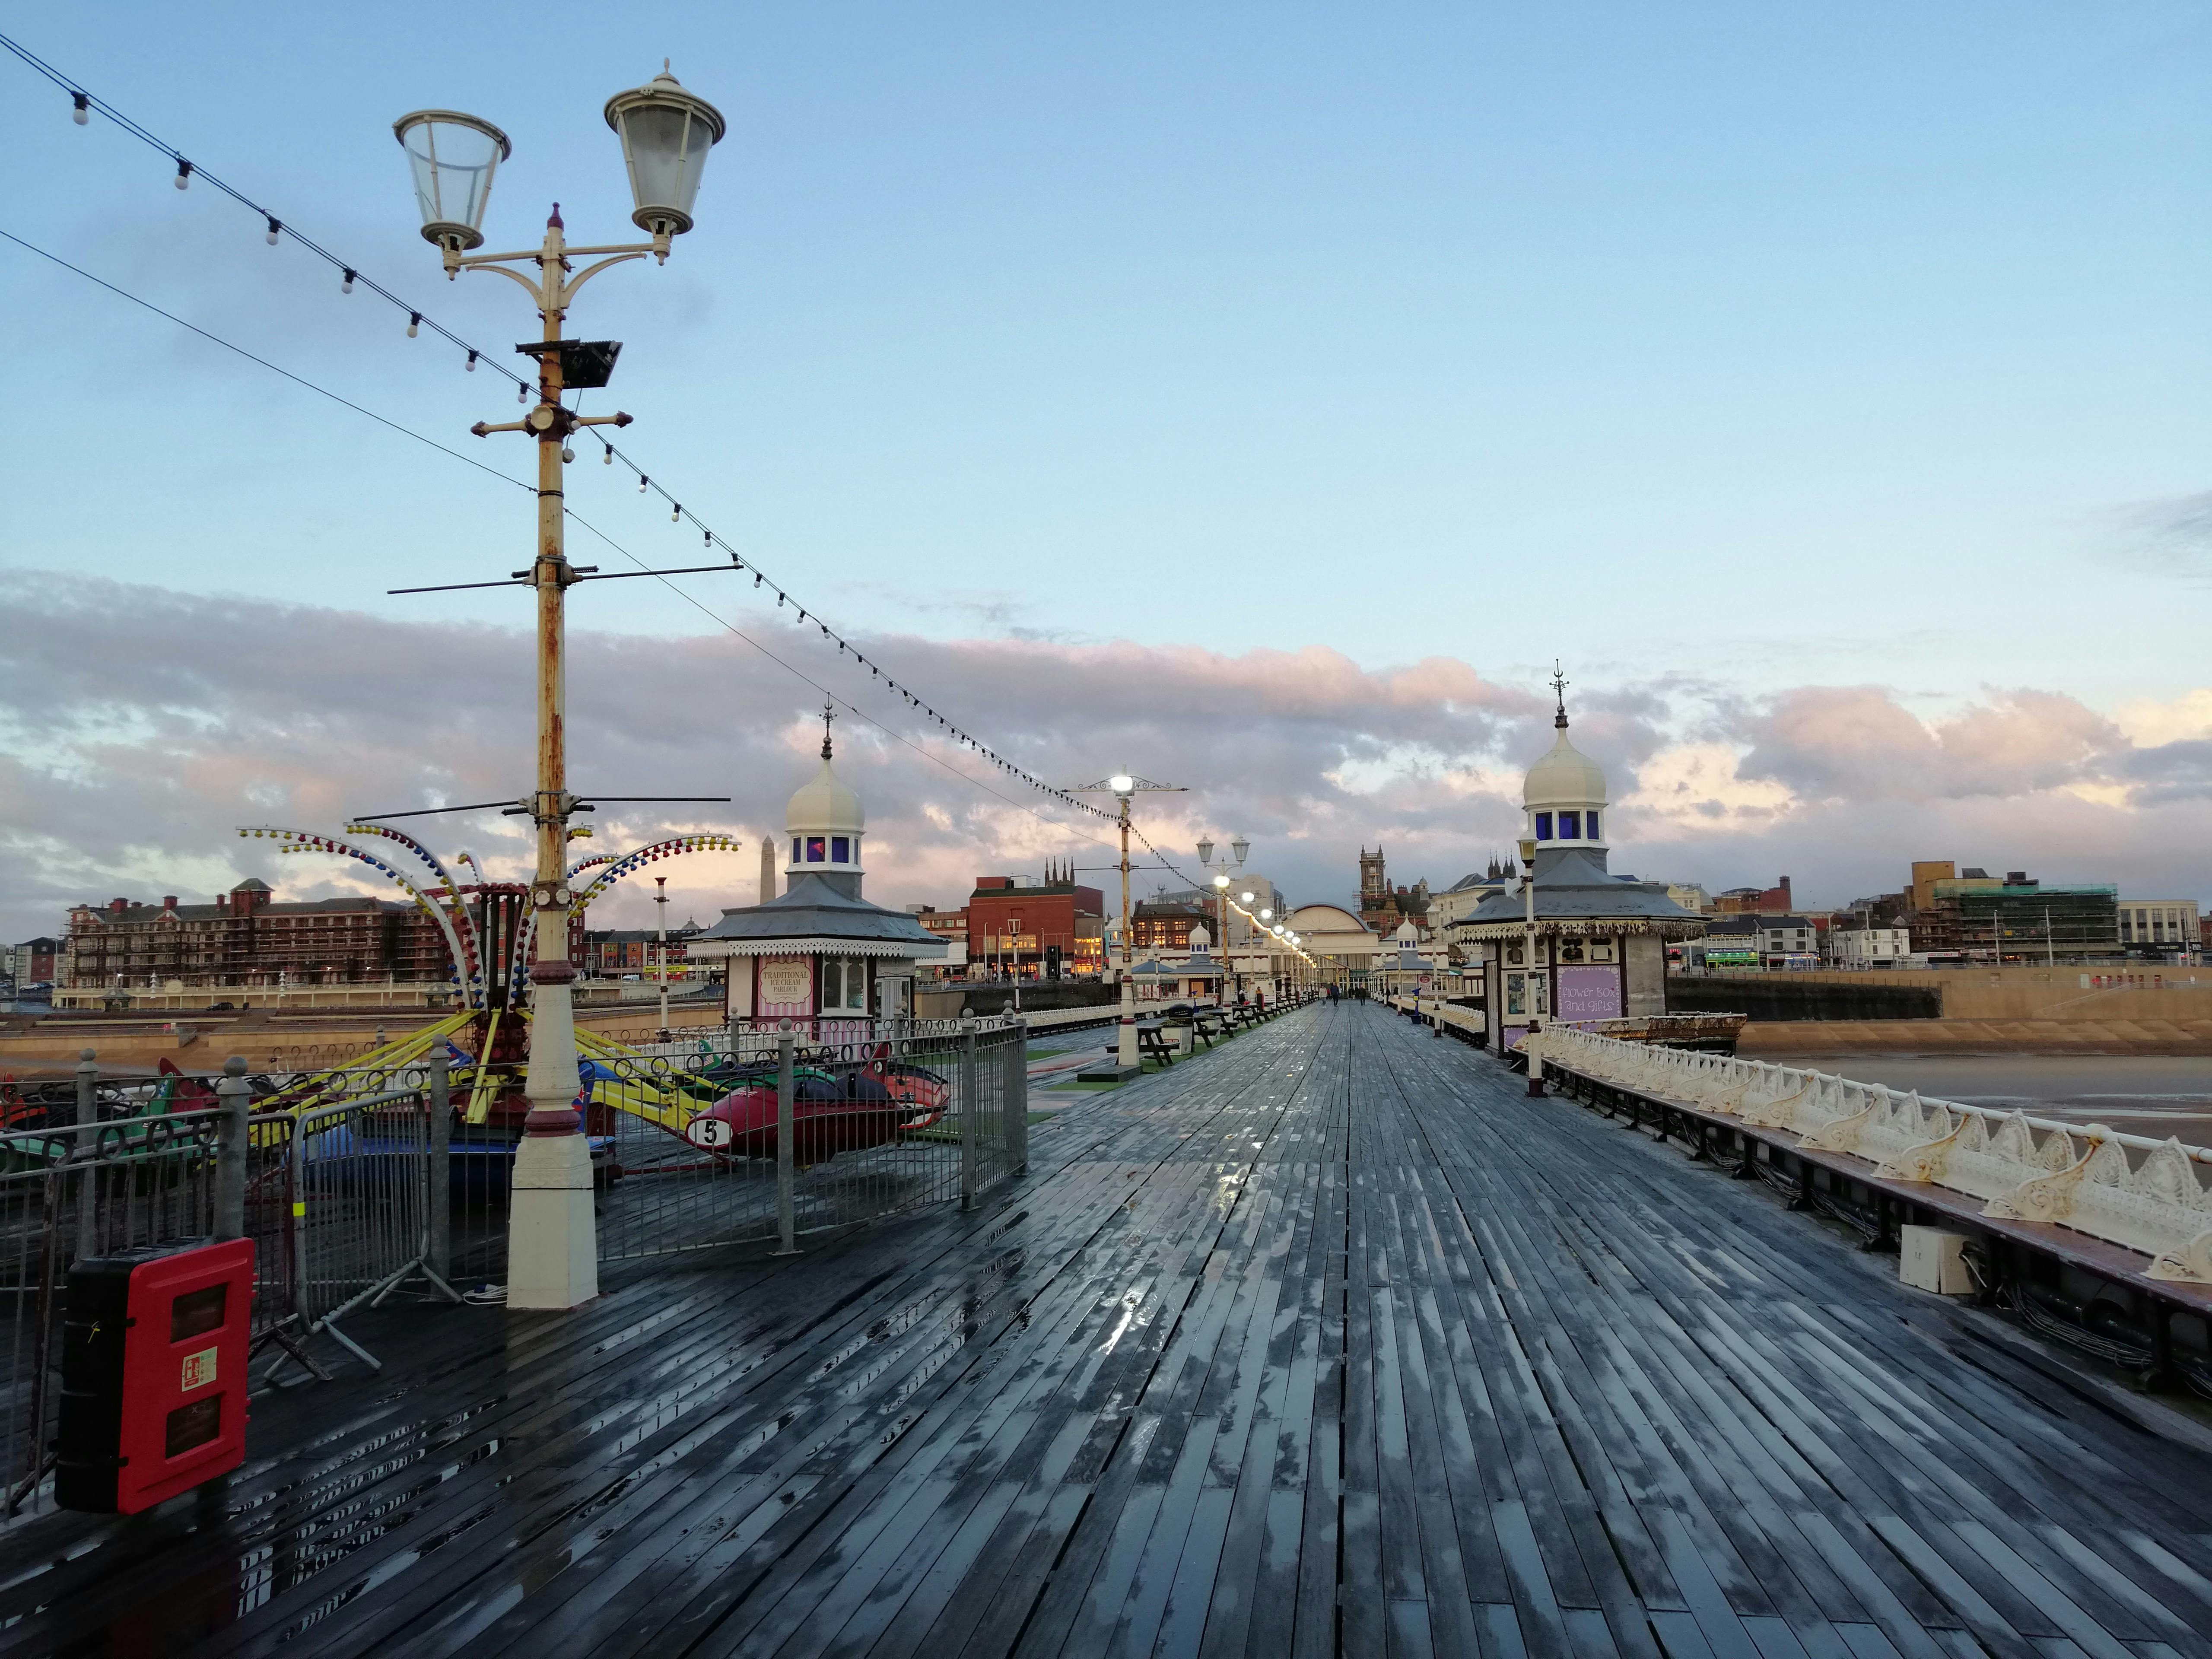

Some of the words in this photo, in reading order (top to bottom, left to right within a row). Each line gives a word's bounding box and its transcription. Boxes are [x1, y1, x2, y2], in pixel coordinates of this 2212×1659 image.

[1564, 1000, 1586, 1011] and
[1588, 1000, 1615, 1012] gifts
[704, 1120, 717, 1144] 5
